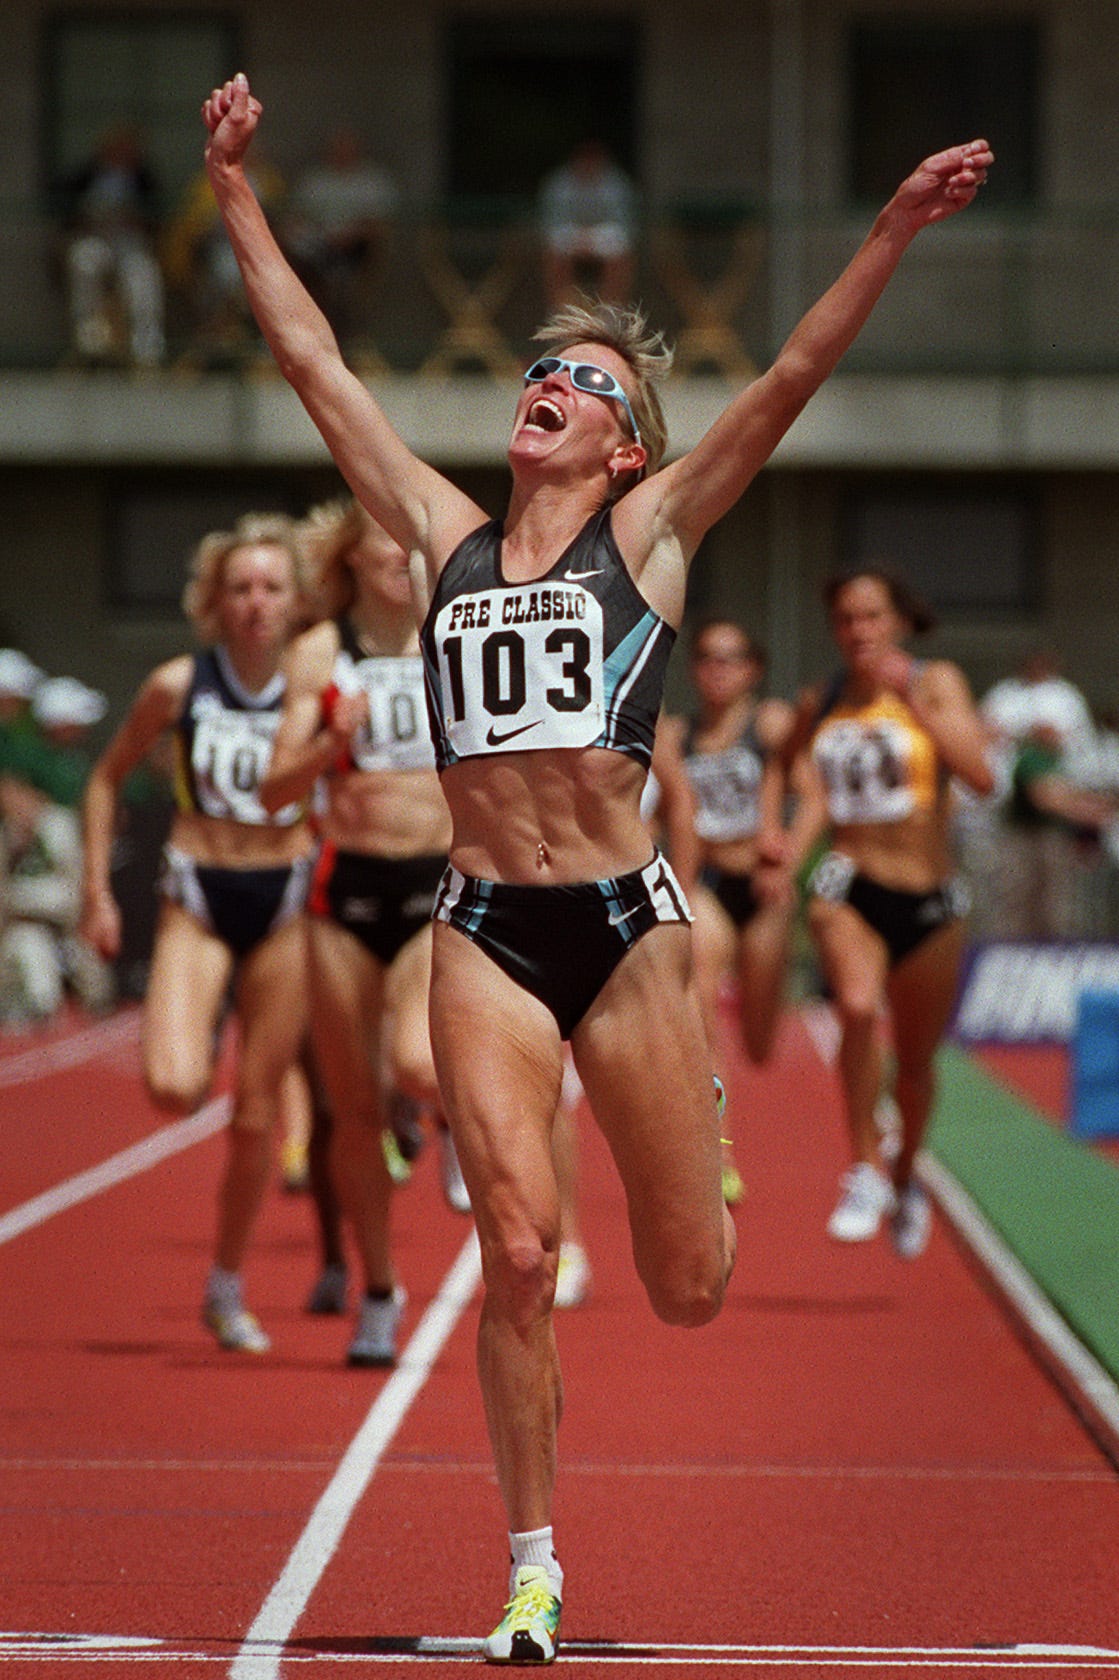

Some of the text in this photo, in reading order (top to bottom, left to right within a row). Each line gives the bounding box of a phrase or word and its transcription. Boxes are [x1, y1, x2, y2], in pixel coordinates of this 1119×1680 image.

[448, 589, 587, 631] PRE CLASSIC
[442, 627, 592, 723] 103
